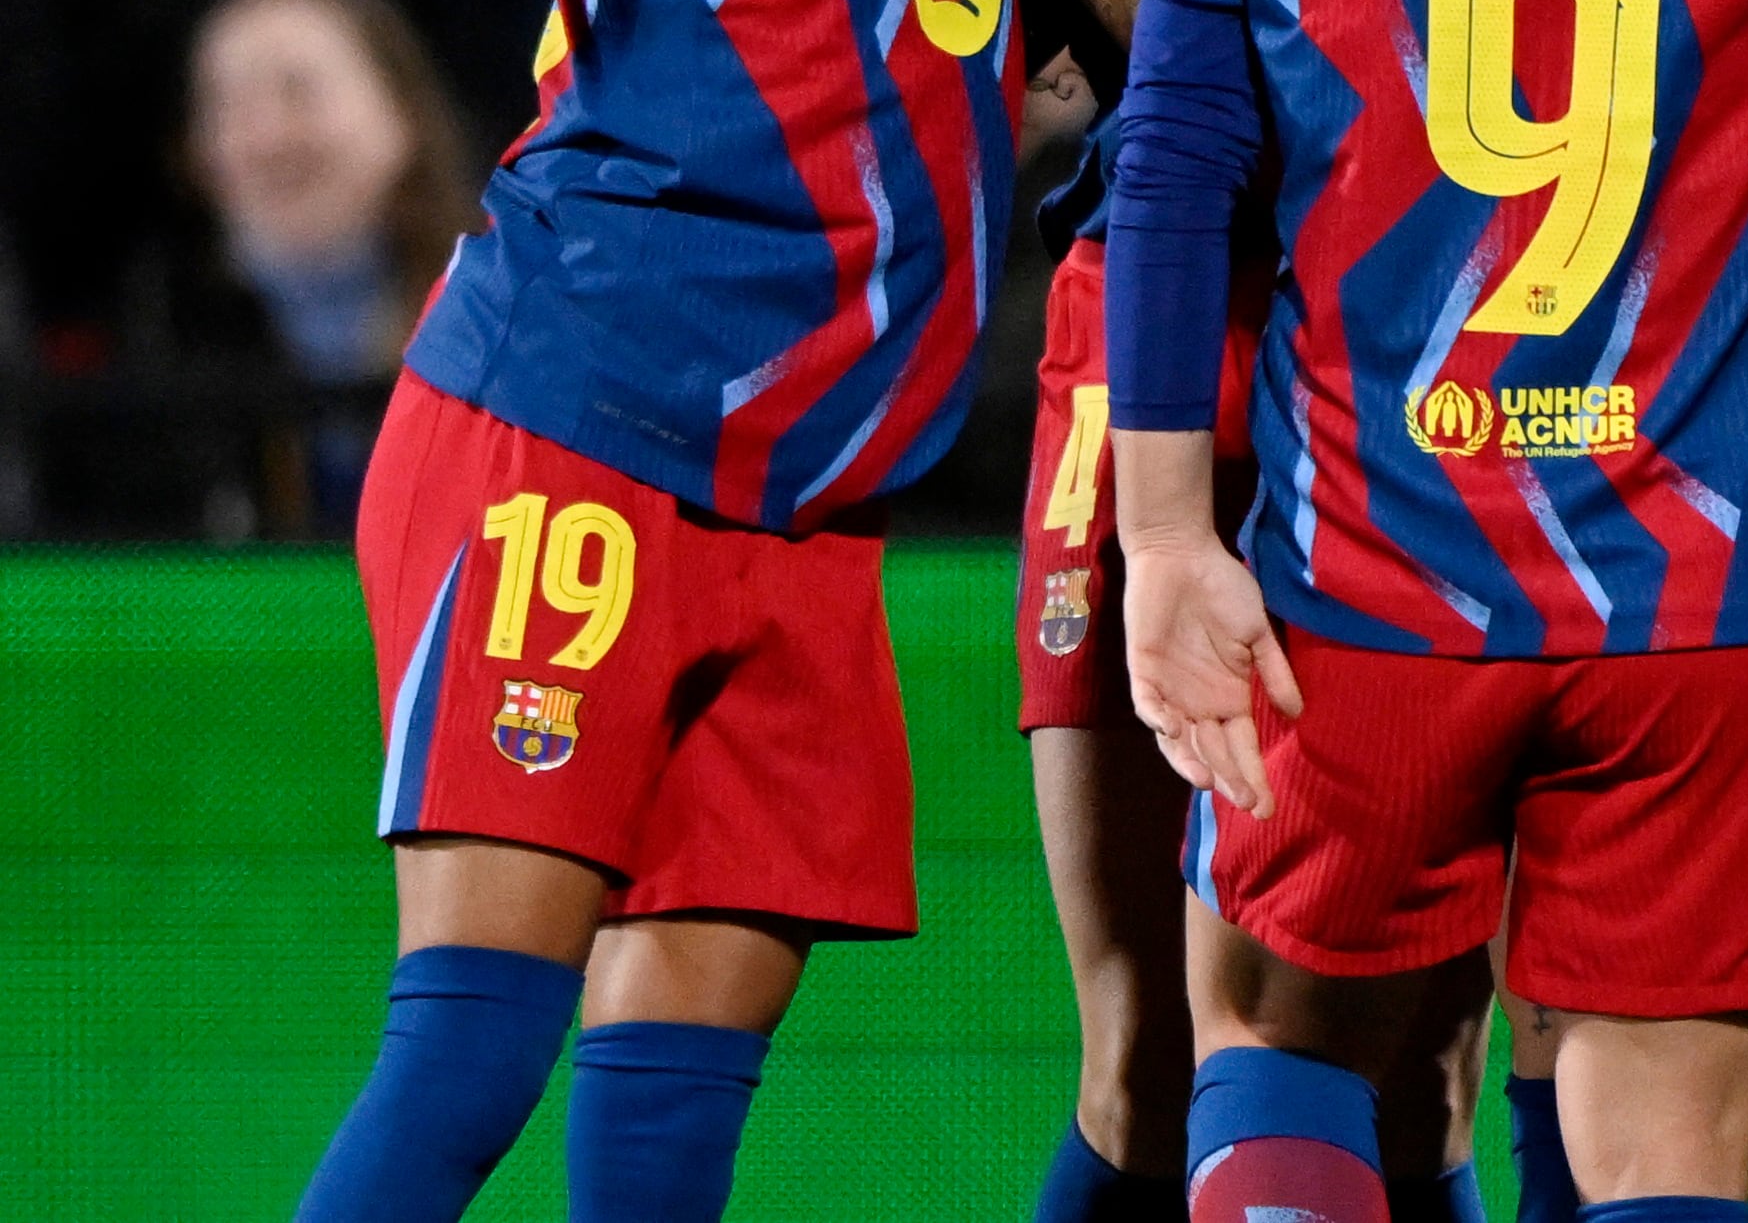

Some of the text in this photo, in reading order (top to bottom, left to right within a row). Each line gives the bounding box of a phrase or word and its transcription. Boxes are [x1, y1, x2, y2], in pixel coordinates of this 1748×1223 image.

[1501, 385, 1636, 416] UNHCR
[1500, 414, 1636, 445] ACNUR
[1501, 441, 1634, 458] The UN Refugee Agency
[1042, 384, 1110, 548] 4
[483, 492, 637, 670] 19
